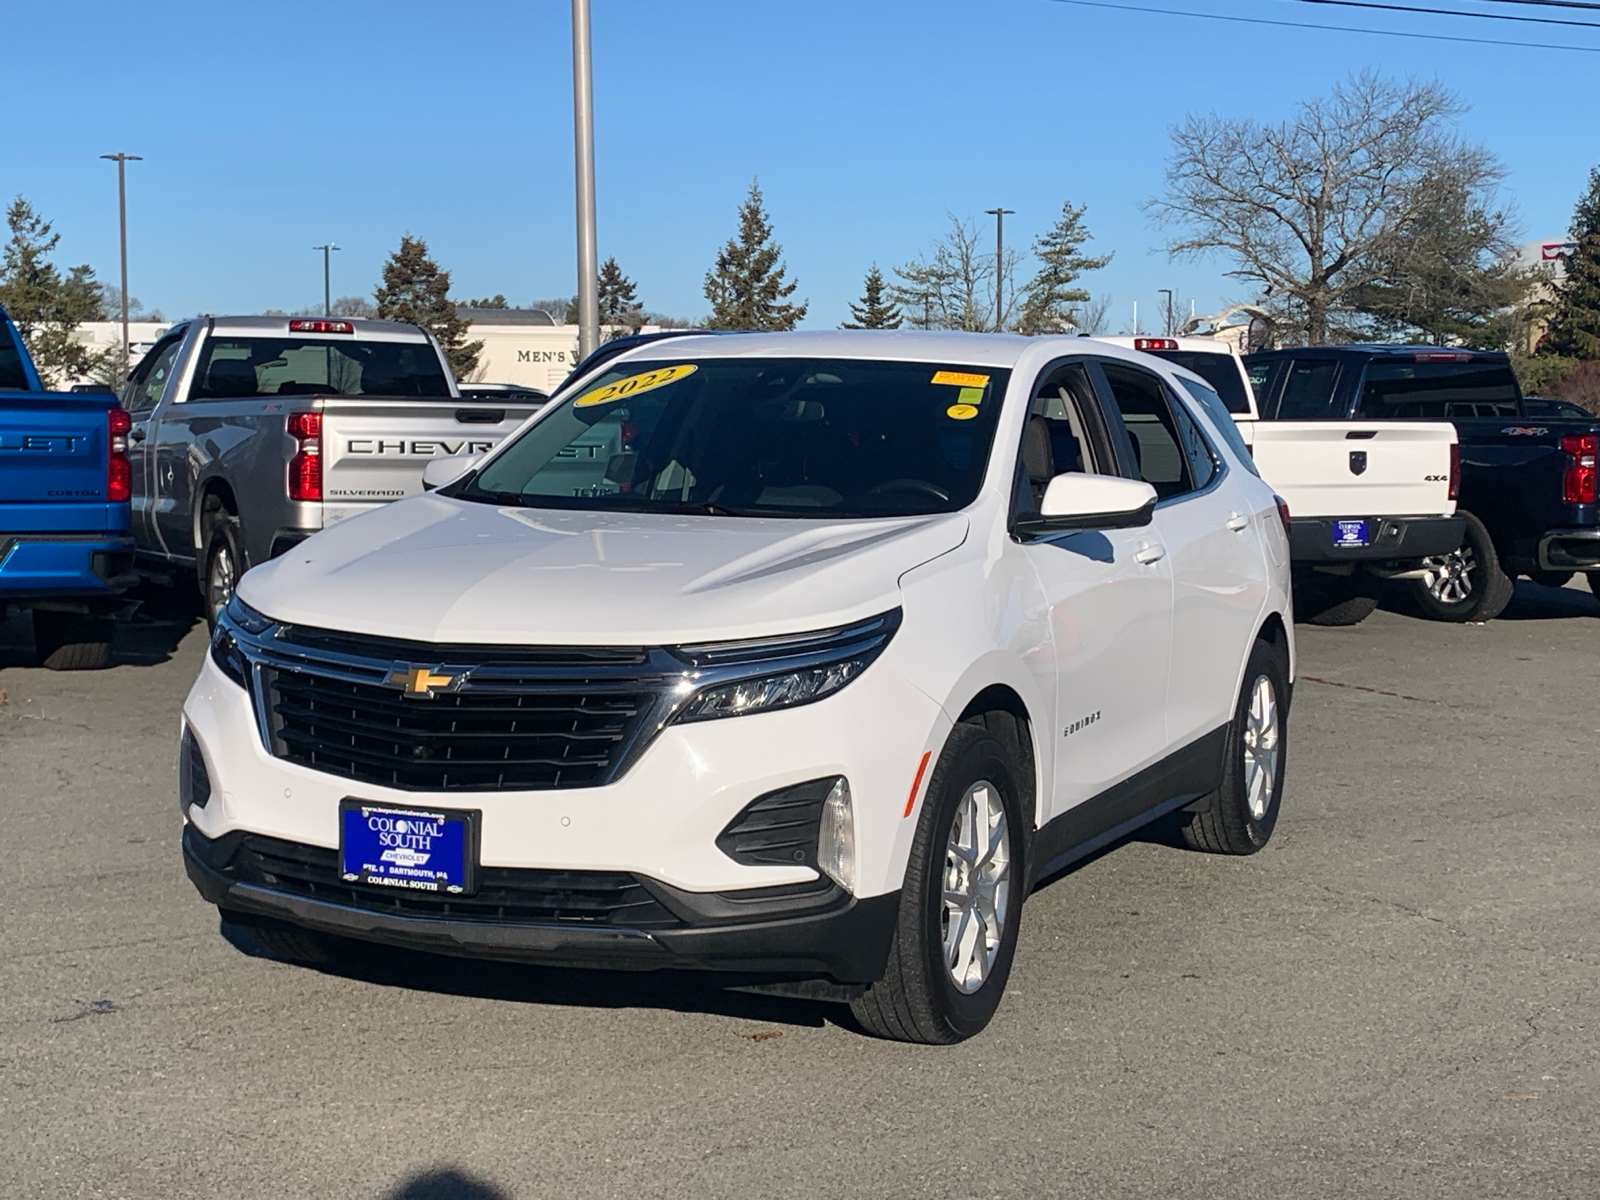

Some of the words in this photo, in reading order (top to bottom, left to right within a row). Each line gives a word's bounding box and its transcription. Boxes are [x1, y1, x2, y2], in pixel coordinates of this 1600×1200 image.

[517, 350, 566, 362] MEN'S
[597, 368, 677, 402] 2022
[329, 489, 405, 497] SILVERADO
[368, 816, 443, 837] COLONIAL
[379, 832, 431, 850] SOUTH
[385, 852, 425, 862] CHEVROLET
[389, 866, 436, 879] DARTMOUTH,
[367, 875, 409, 888] COLONIAL
[409, 880, 438, 891] SOUTH
